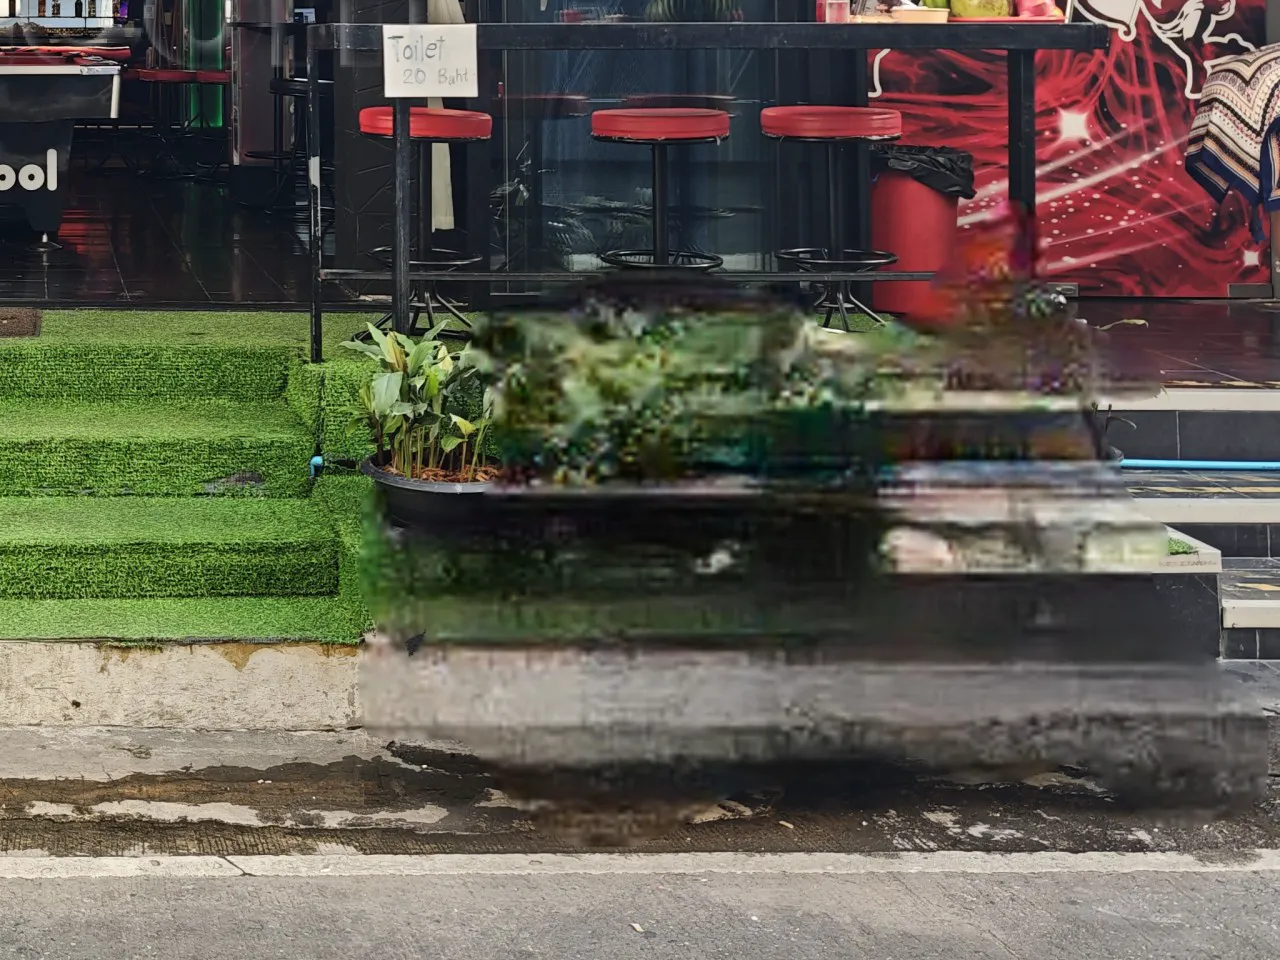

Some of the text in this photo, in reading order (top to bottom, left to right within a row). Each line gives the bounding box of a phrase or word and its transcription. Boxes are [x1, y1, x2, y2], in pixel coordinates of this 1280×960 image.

[387, 34, 446, 63] Toilet
[402, 67, 469, 86] 20 Baht
